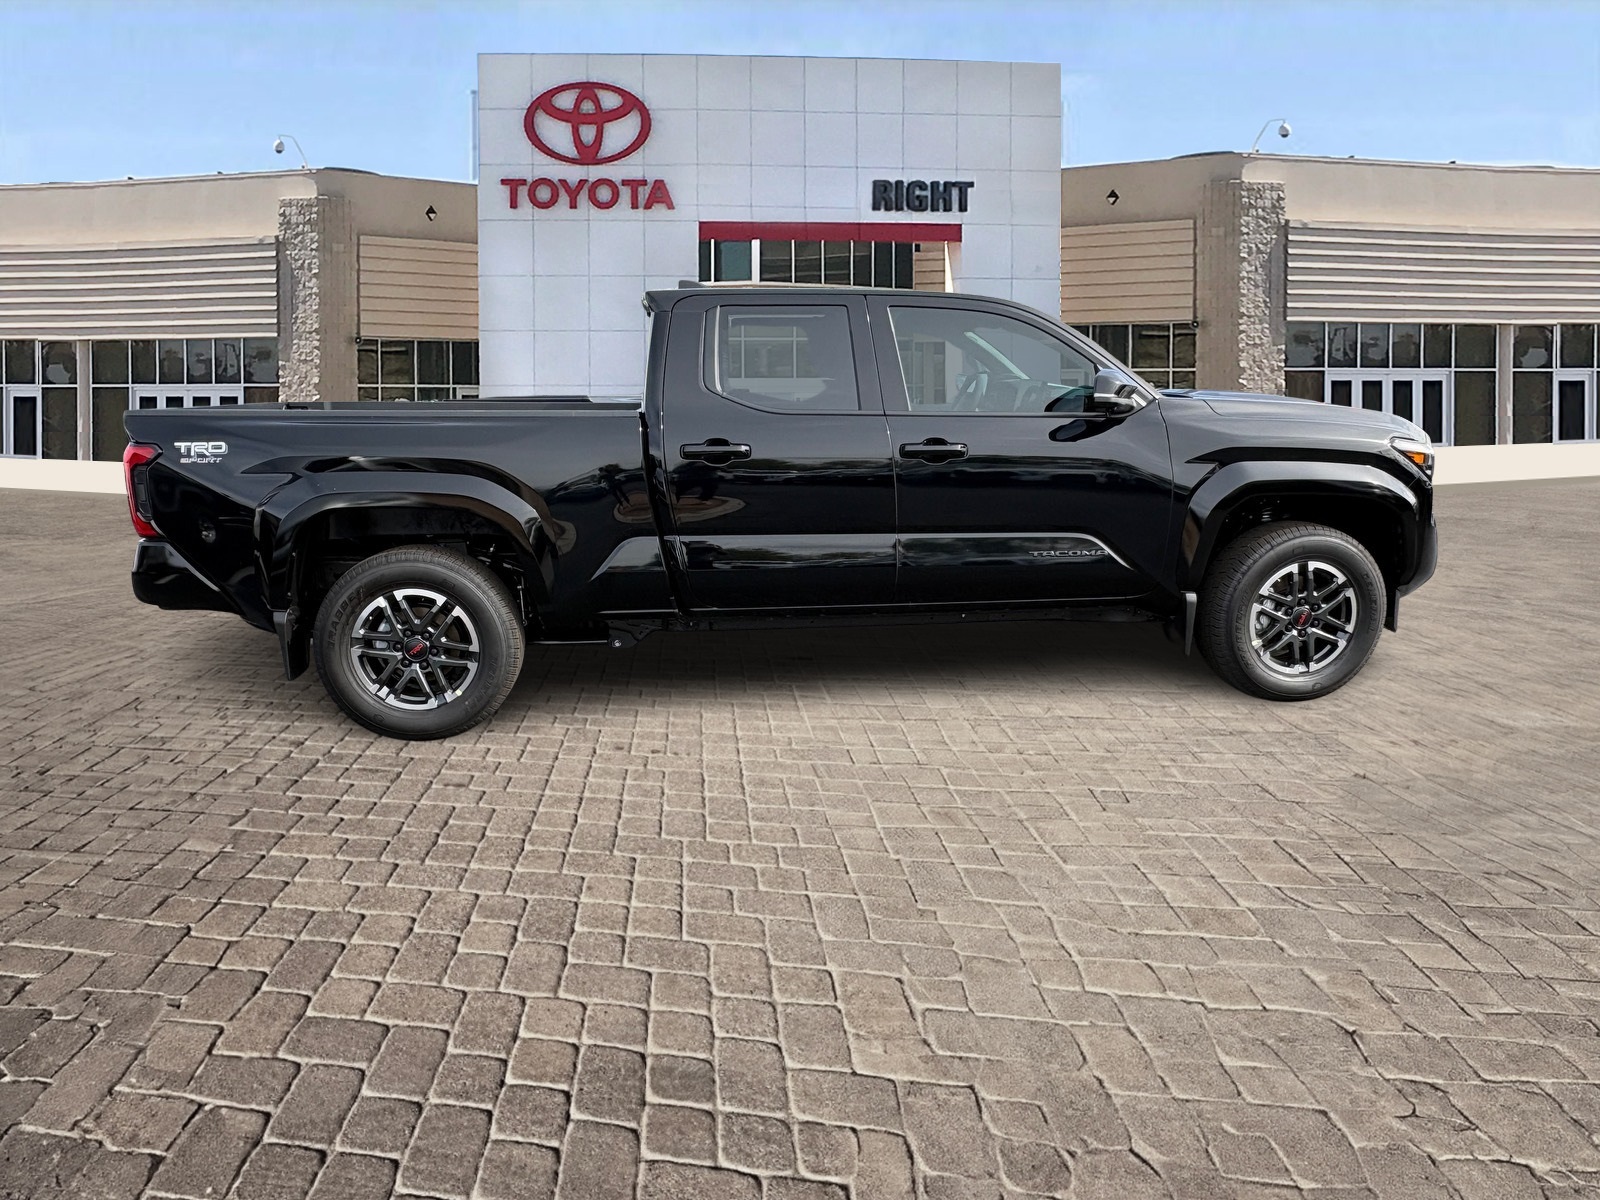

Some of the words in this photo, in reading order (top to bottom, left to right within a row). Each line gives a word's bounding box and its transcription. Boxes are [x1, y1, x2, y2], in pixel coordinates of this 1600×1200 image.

[500, 177, 675, 210] TOYOTA
[872, 179, 975, 212] RIGHT
[173, 441, 228, 456] TRD
[1028, 549, 1109, 558] TACOMA
